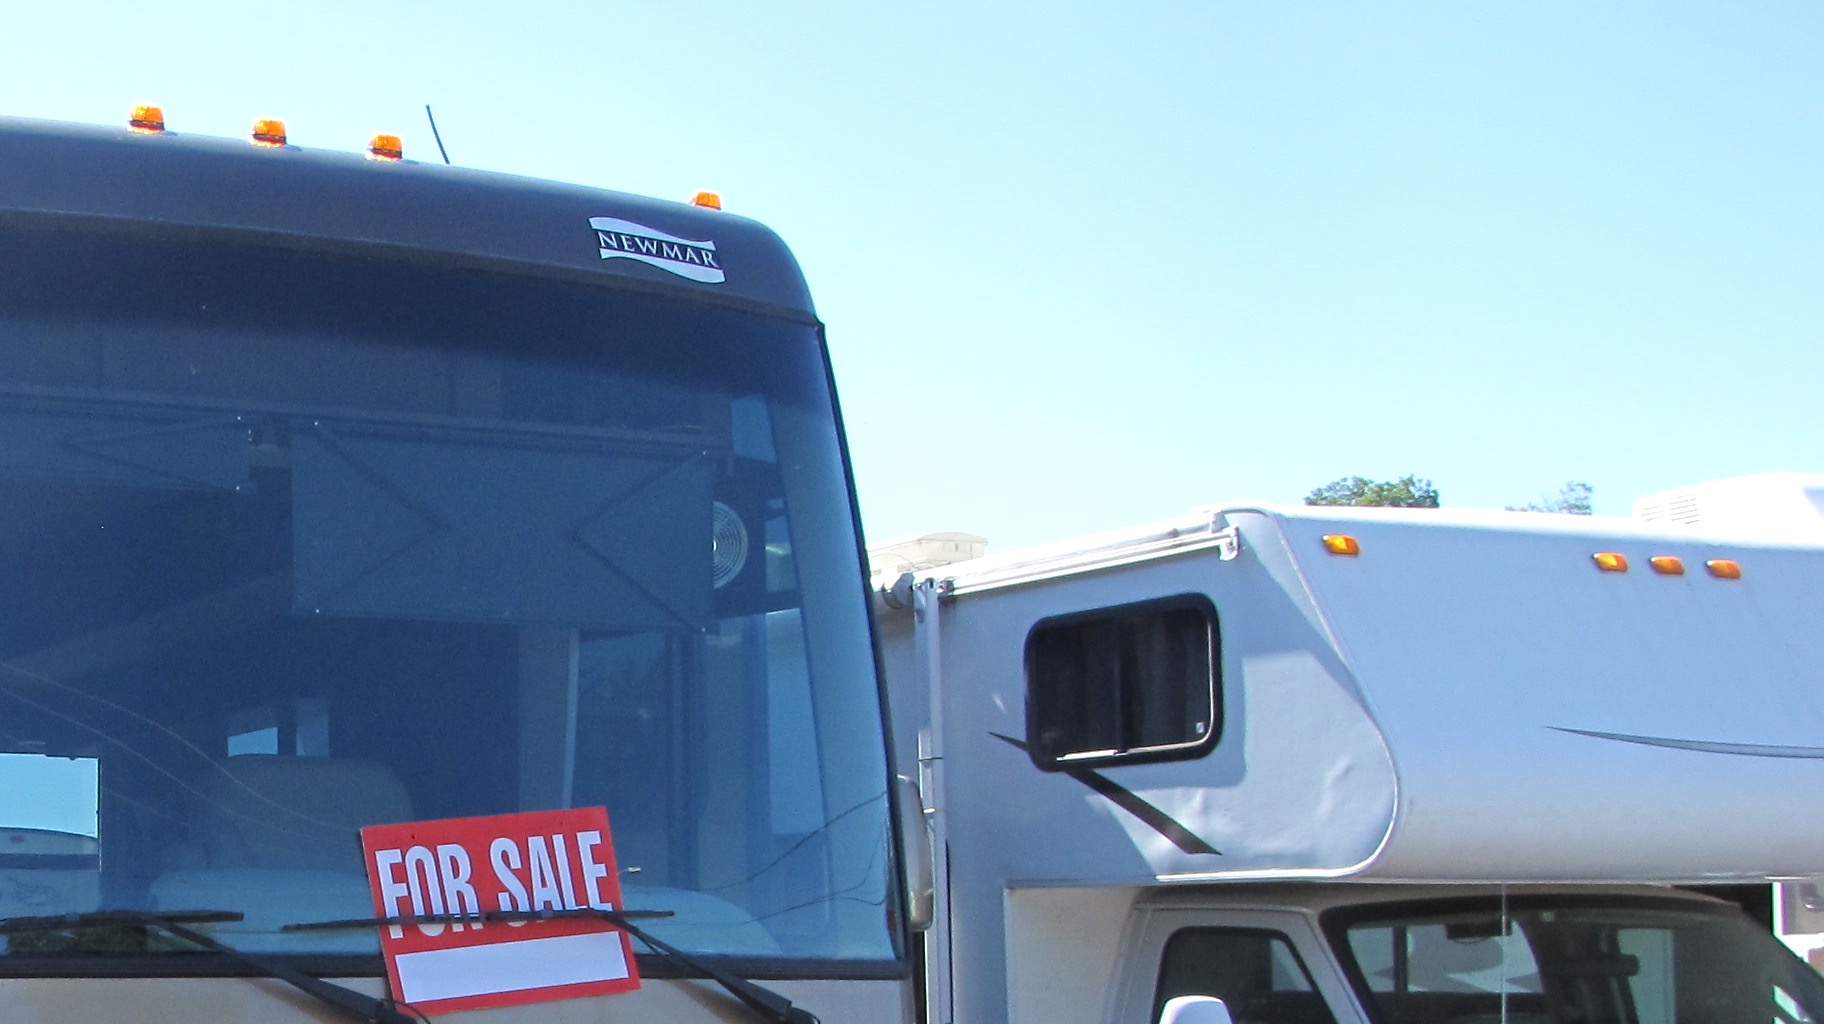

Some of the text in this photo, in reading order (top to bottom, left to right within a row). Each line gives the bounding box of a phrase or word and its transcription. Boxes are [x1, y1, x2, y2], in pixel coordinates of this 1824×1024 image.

[597, 230, 720, 268] NEWMAR
[374, 829, 615, 940] FOR SALE
